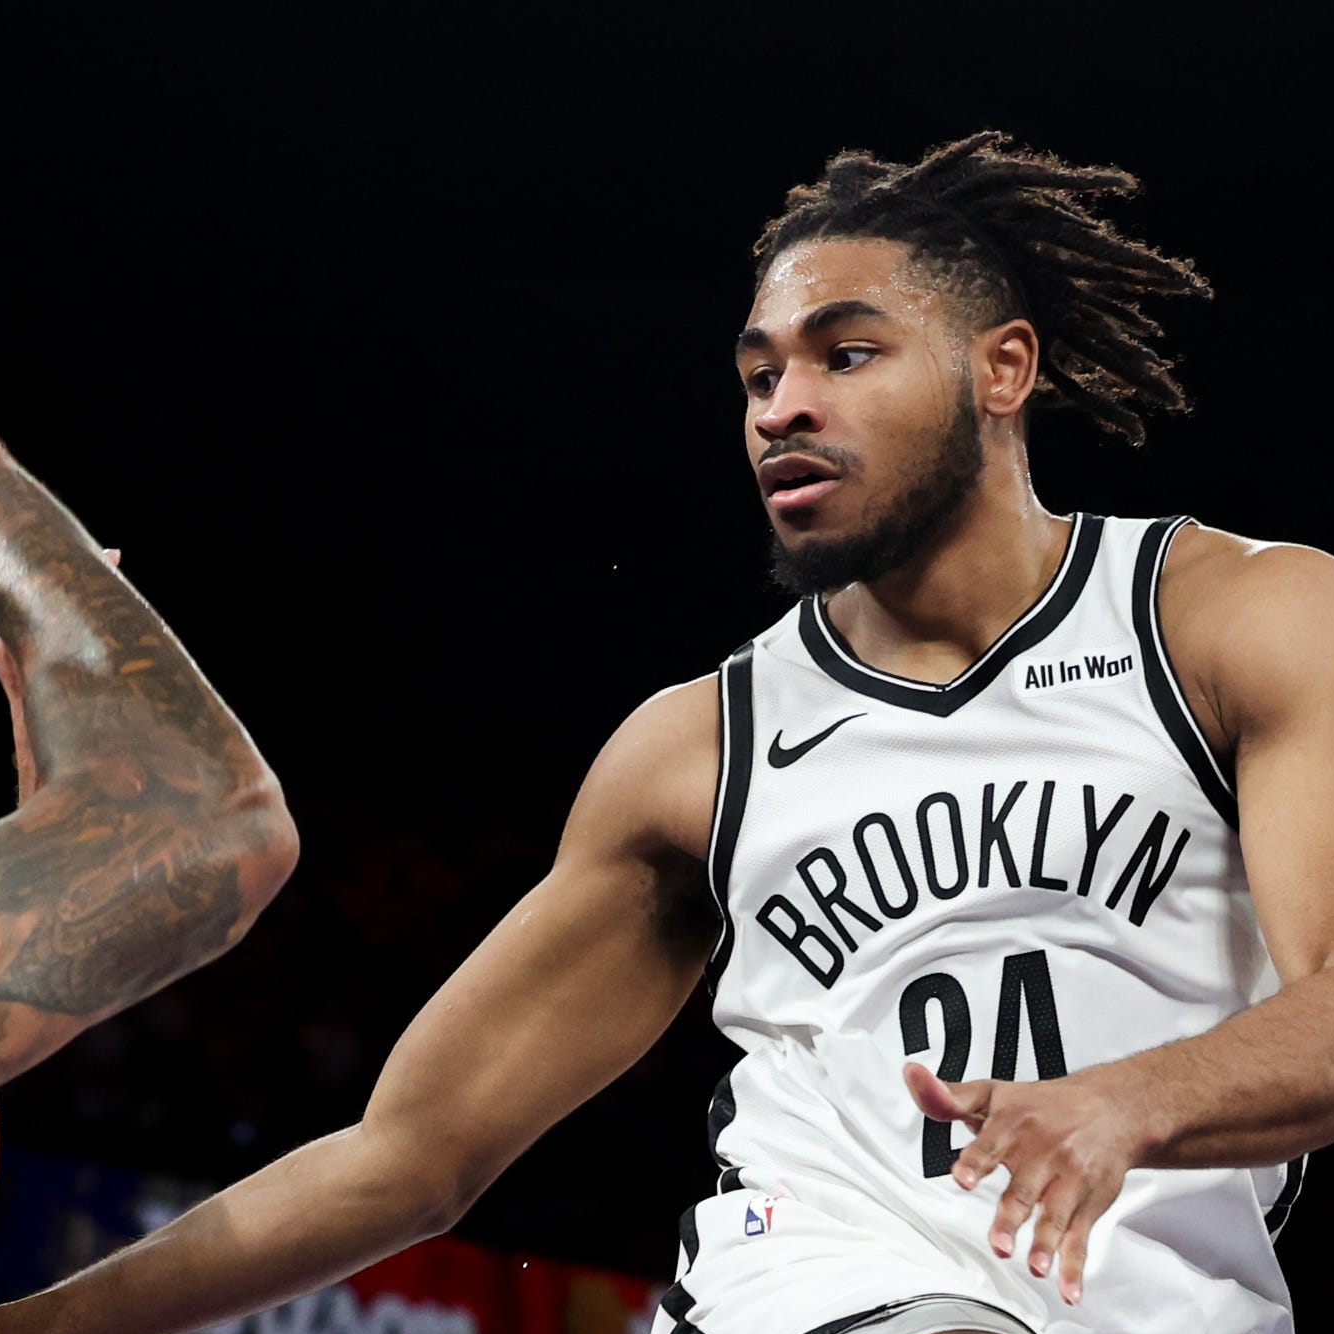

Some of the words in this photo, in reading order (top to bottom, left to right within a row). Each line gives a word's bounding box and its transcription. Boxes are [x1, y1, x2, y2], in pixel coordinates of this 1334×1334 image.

[1025, 664, 1054, 690] All
[1059, 660, 1081, 684] In
[1083, 654, 1133, 679] Won
[755, 779, 1192, 990] BROOKLYN
